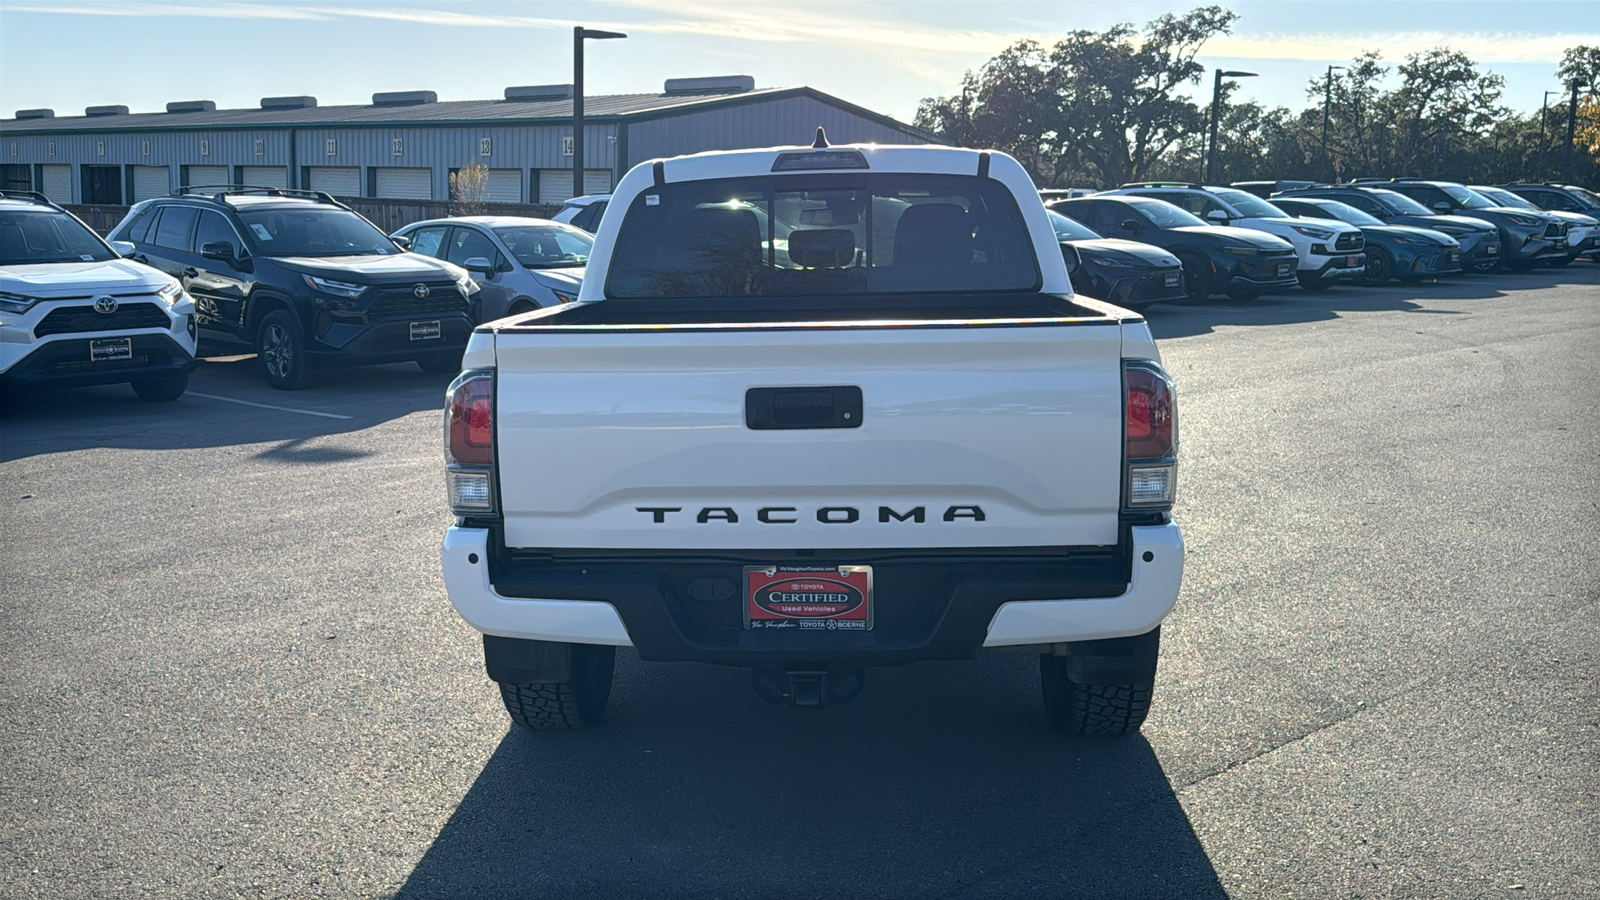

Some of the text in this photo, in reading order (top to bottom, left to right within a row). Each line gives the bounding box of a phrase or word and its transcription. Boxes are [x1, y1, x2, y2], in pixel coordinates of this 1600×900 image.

[256, 141, 263, 154] 10
[327, 141, 335, 154] 11
[393, 140, 402, 154] 12
[481, 139, 490, 154] 13
[563, 138, 573, 154] 14
[635, 506, 986, 524] TACOMA
[768, 591, 848, 603] CERTIFIED
